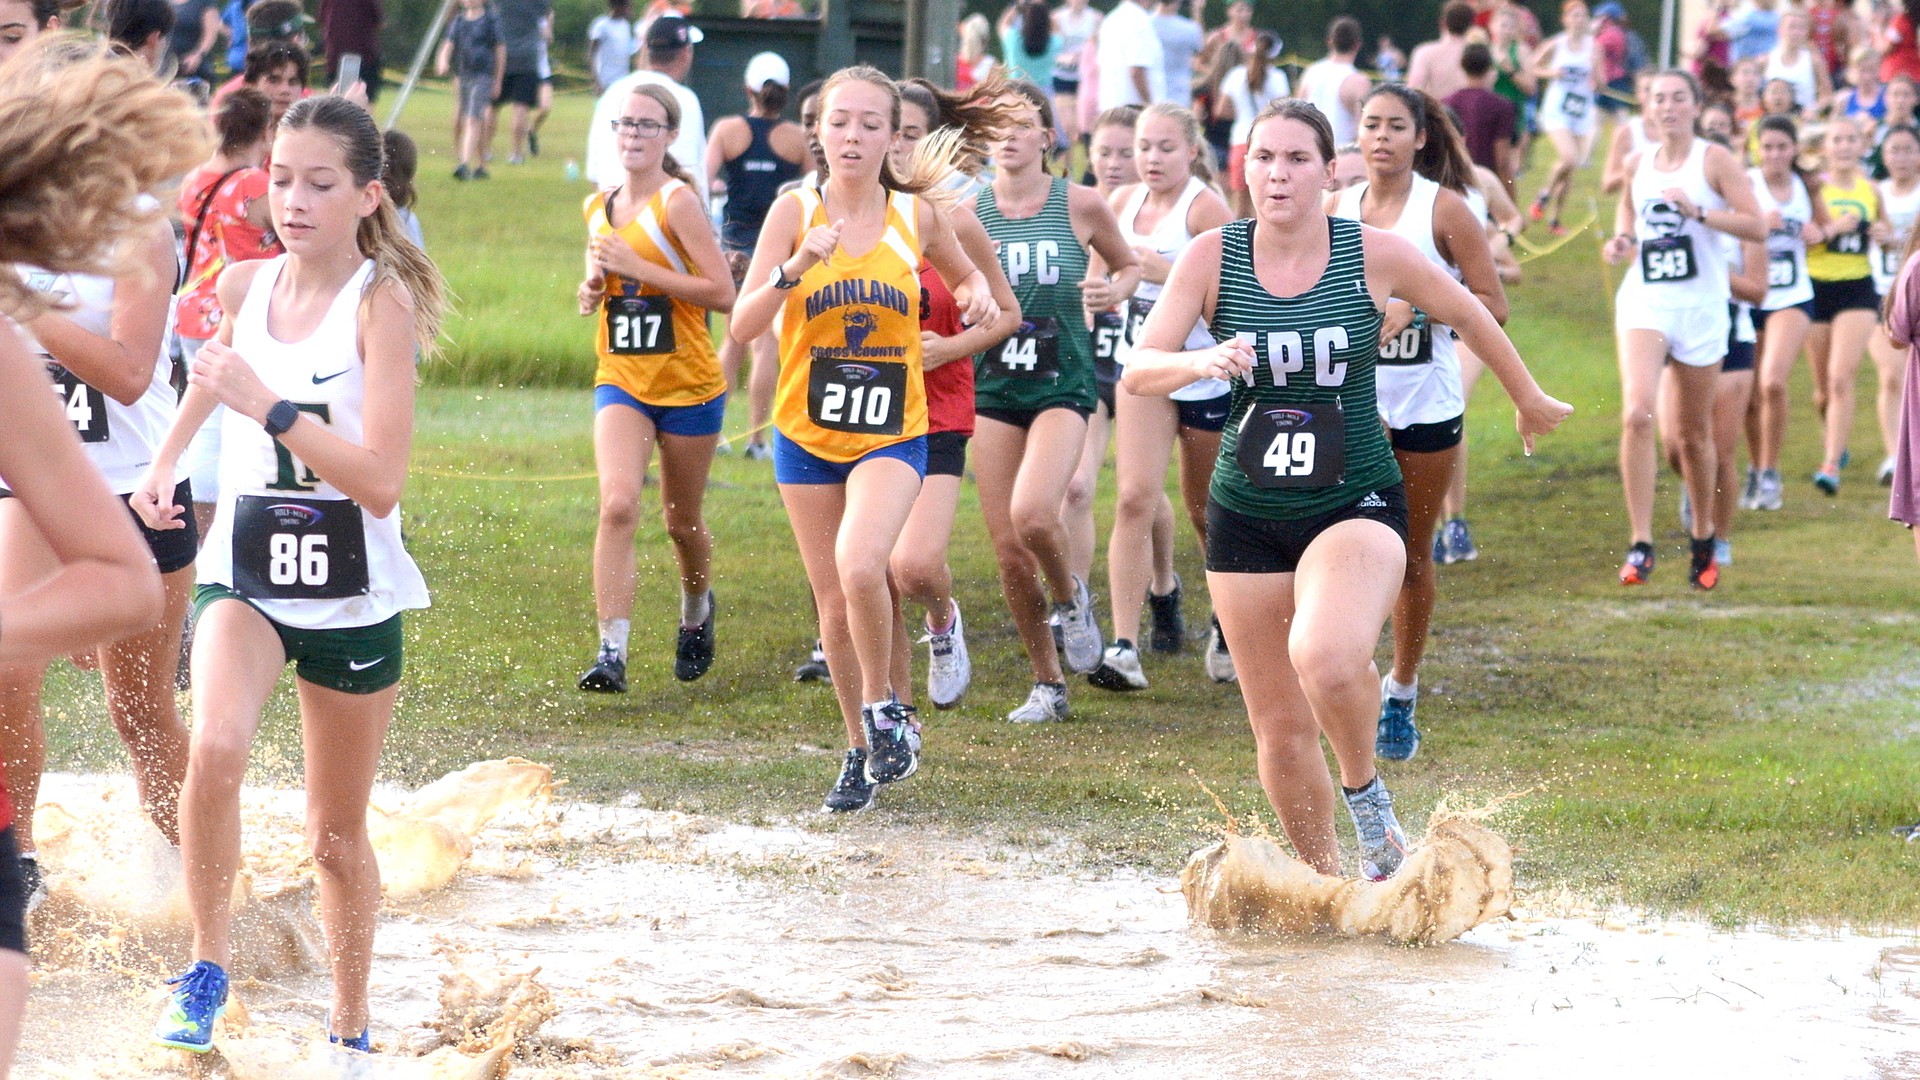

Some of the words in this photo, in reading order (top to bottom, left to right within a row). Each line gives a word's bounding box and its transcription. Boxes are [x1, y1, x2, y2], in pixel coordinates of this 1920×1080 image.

[996, 240, 1060, 287] PC
[1647, 248, 1688, 280] 543
[806, 278, 909, 322] MAINLAND
[615, 314, 662, 348] 217
[810, 345, 849, 357] CROSS
[853, 345, 908, 357] COUNTRY
[1001, 337, 1038, 371] 44
[821, 383, 891, 426] 210
[1263, 432, 1316, 476] 49
[270, 533, 329, 585] 86
